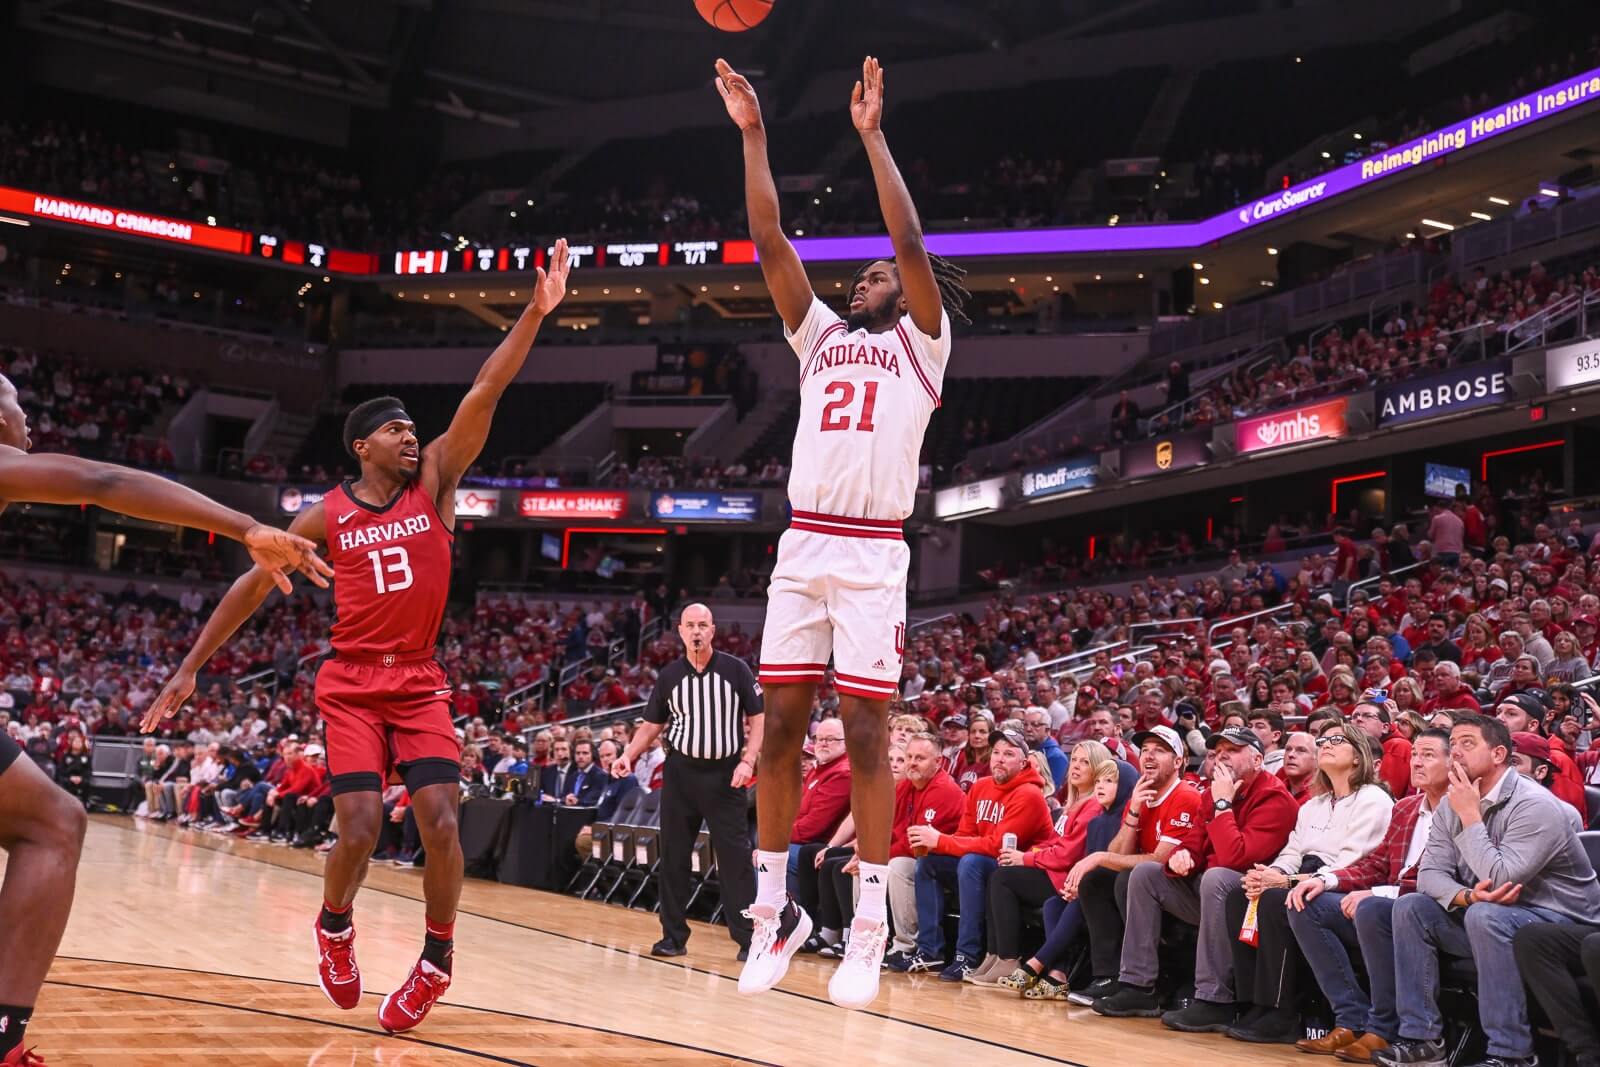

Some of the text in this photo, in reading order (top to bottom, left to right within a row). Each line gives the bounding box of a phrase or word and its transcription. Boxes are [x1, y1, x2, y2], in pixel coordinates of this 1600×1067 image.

[1361, 126, 1466, 179] Reimagining
[1471, 101, 1531, 139] Health
[1253, 181, 1327, 220] CareSource
[34, 197, 192, 241] HARVARD CRIMSON
[619, 252, 645, 267] 0/0
[685, 251, 706, 265] 1/1
[812, 343, 901, 378] INDIANA
[1577, 352, 1600, 372] 93.5
[820, 381, 879, 433] 21
[1381, 372, 1505, 418] AMBROSE
[1280, 411, 1320, 442] mhs
[1035, 467, 1067, 490] Ruoff
[522, 497, 566, 512] STEAK
[576, 497, 622, 512] SHAKE
[339, 513, 431, 551] HARVARD
[367, 546, 414, 595] 13
